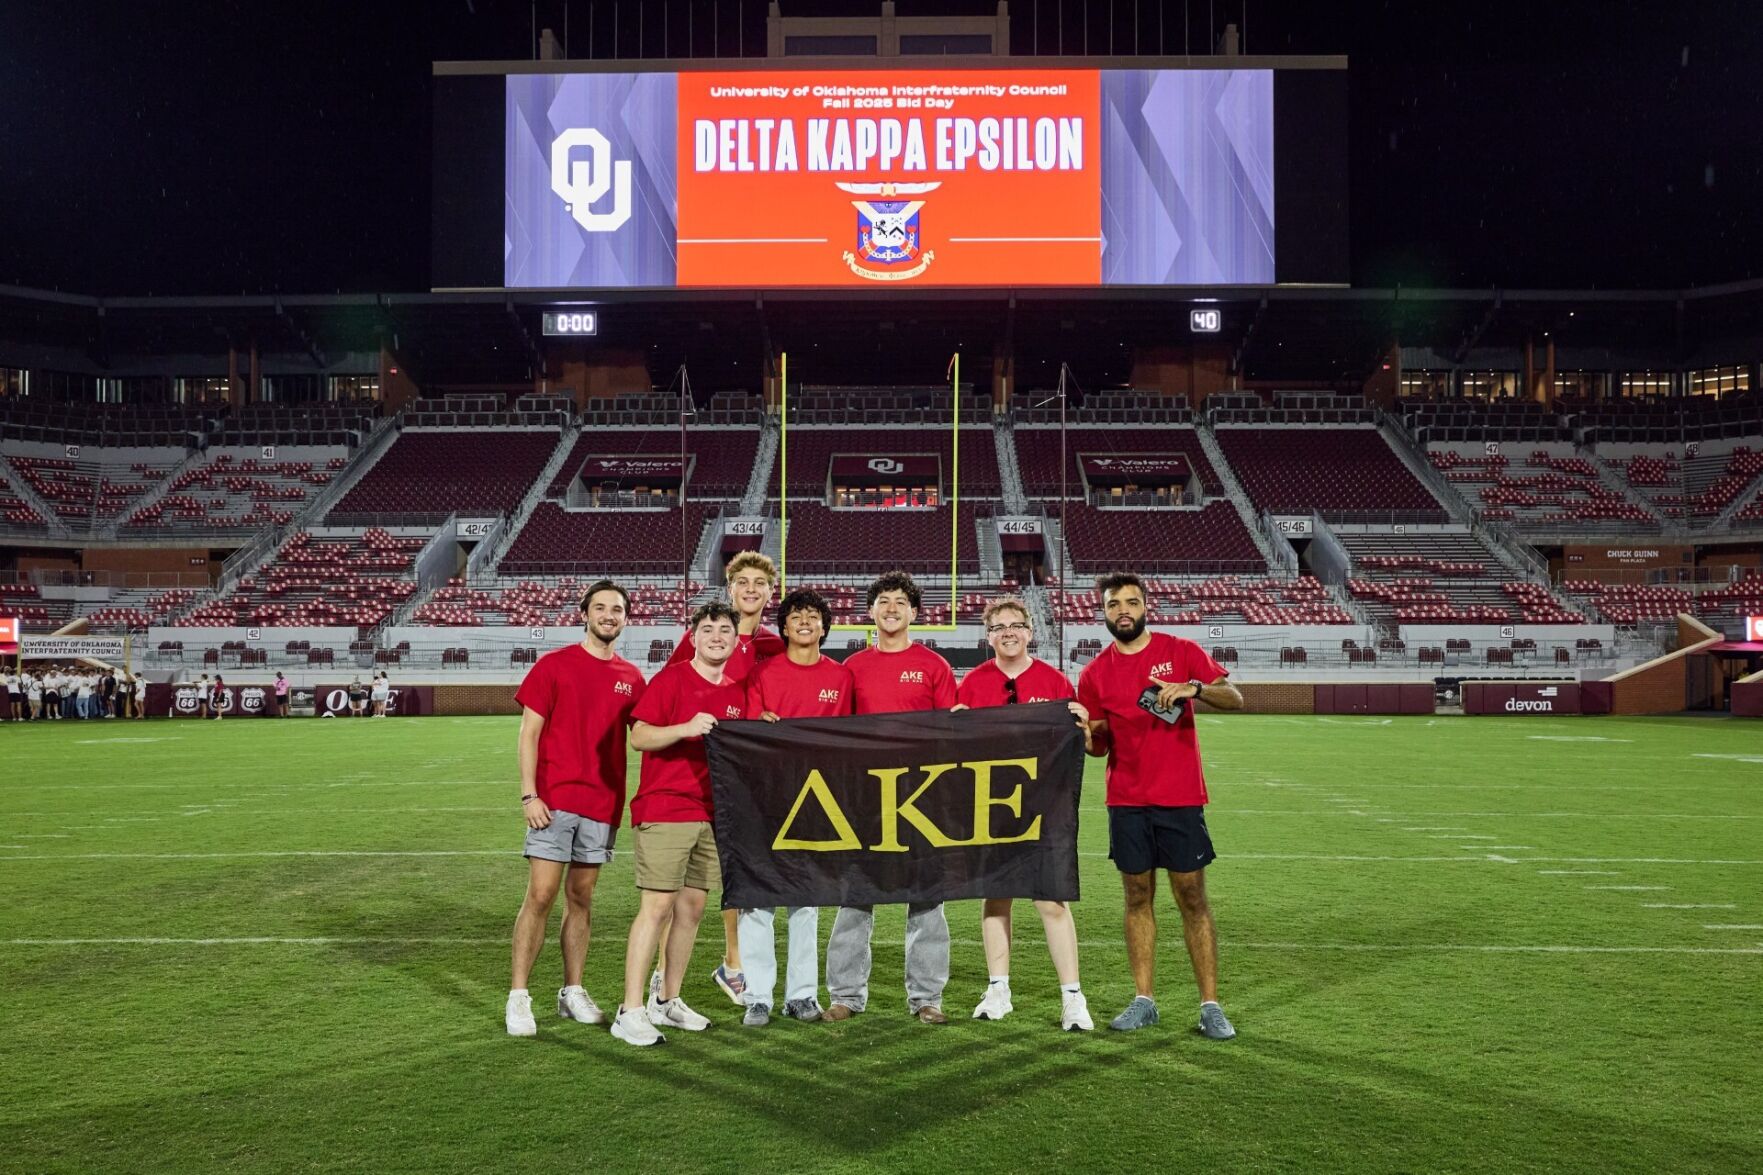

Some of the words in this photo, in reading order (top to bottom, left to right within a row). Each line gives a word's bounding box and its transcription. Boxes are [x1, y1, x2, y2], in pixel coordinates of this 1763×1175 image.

[710, 86, 789, 98] University
[792, 86, 810, 97] of
[812, 85, 888, 97] Oklahoma
[892, 85, 1006, 97] Interfraternity
[1009, 84, 1067, 96] Council
[822, 98, 850, 108] Fall
[853, 98, 894, 108] 2025
[896, 98, 921, 108] Bid
[924, 98, 954, 109] Day
[695, 119, 799, 171] DELTA
[807, 117, 927, 171] KAPPA
[936, 117, 1083, 170] EPSILON
[557, 314, 594, 332] 0:00
[1194, 312, 1217, 329] 40
[66, 446, 79, 457] 40
[263, 447, 273, 457] 41
[465, 524, 493, 535] 42/4
[732, 523, 763, 533] 43/44
[1004, 522, 1035, 532] 44/45
[249, 629, 258, 638] 42
[532, 629, 543, 637] 43
[1210, 627, 1221, 636] 45
[1502, 627, 1513, 636] 46
[180, 698, 195, 707] 66
[246, 698, 260, 707] 66
[1505, 698, 1553, 711] devon
